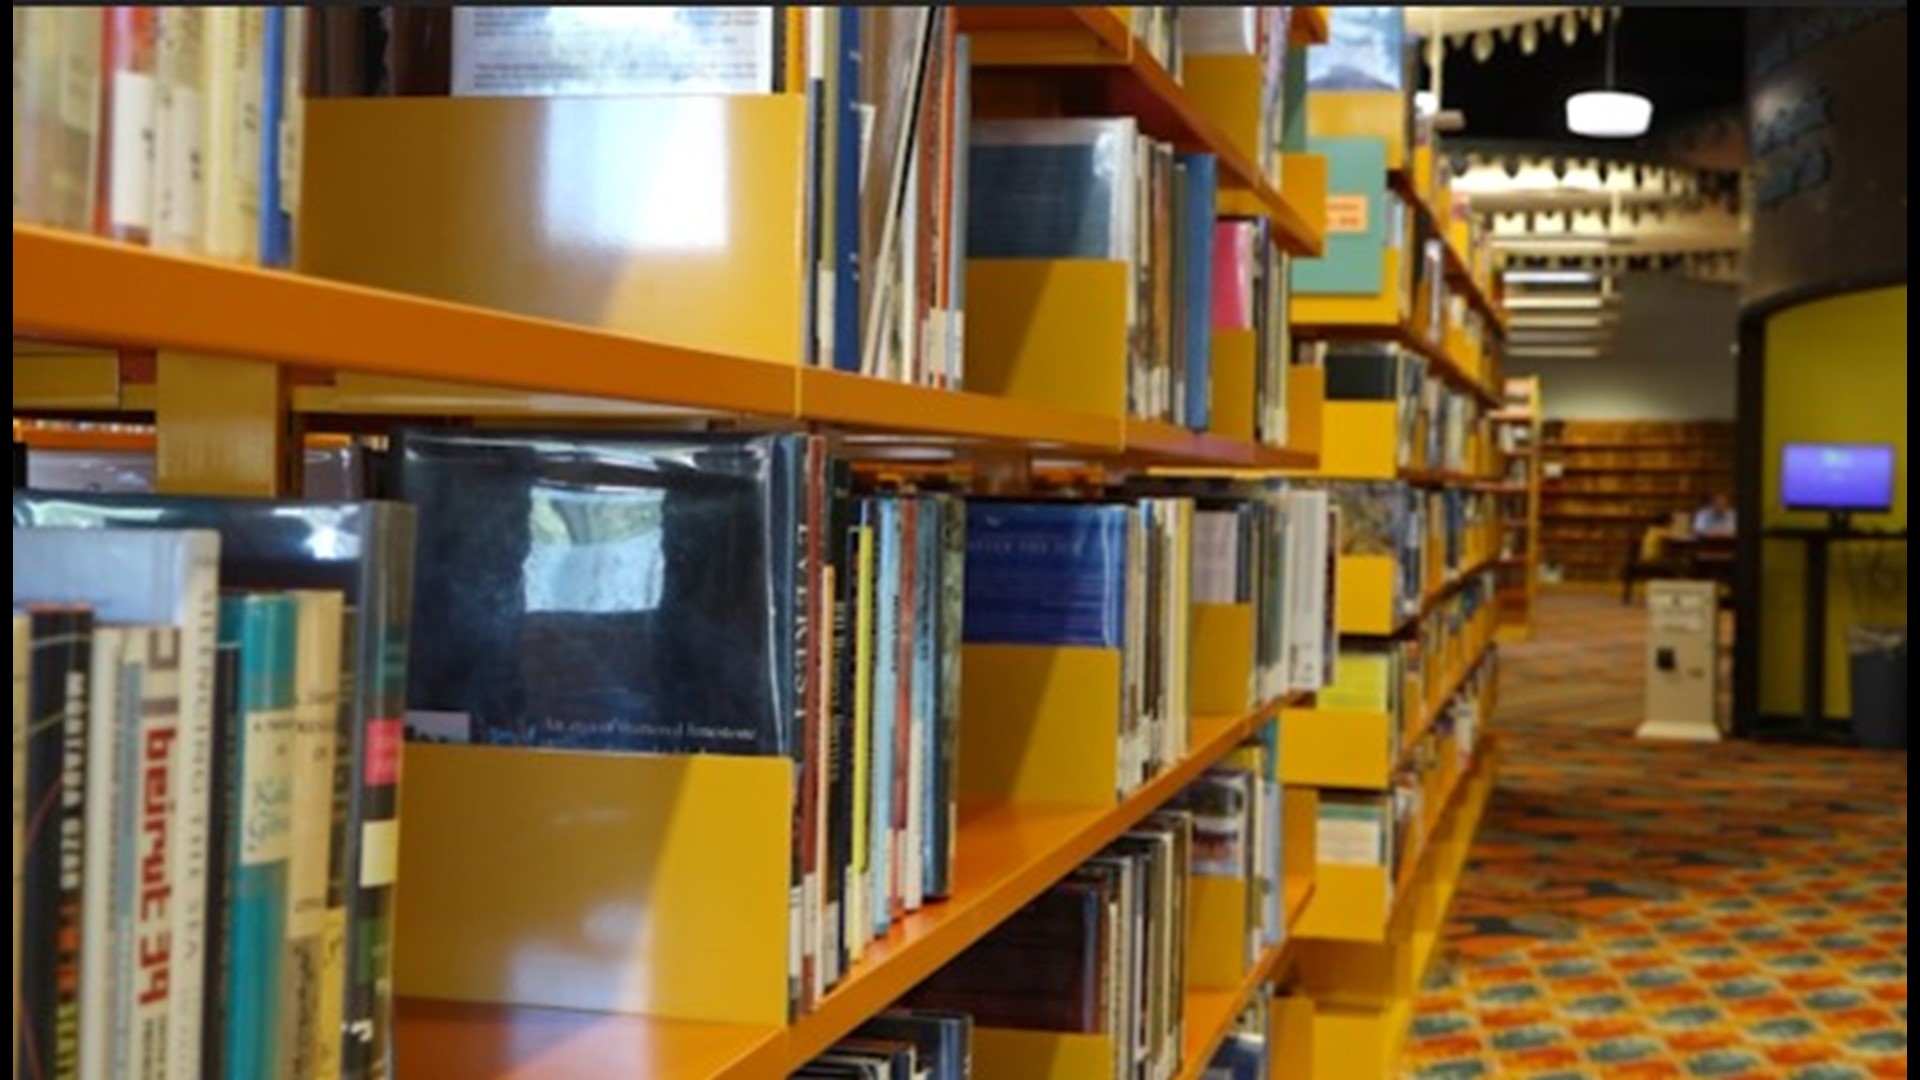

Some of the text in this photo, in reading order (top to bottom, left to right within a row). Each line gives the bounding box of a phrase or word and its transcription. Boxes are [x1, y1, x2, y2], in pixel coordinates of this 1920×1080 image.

[137, 727, 177, 1005] beirut 39
[186, 815, 203, 878] THE
[182, 900, 202, 962] SEA
